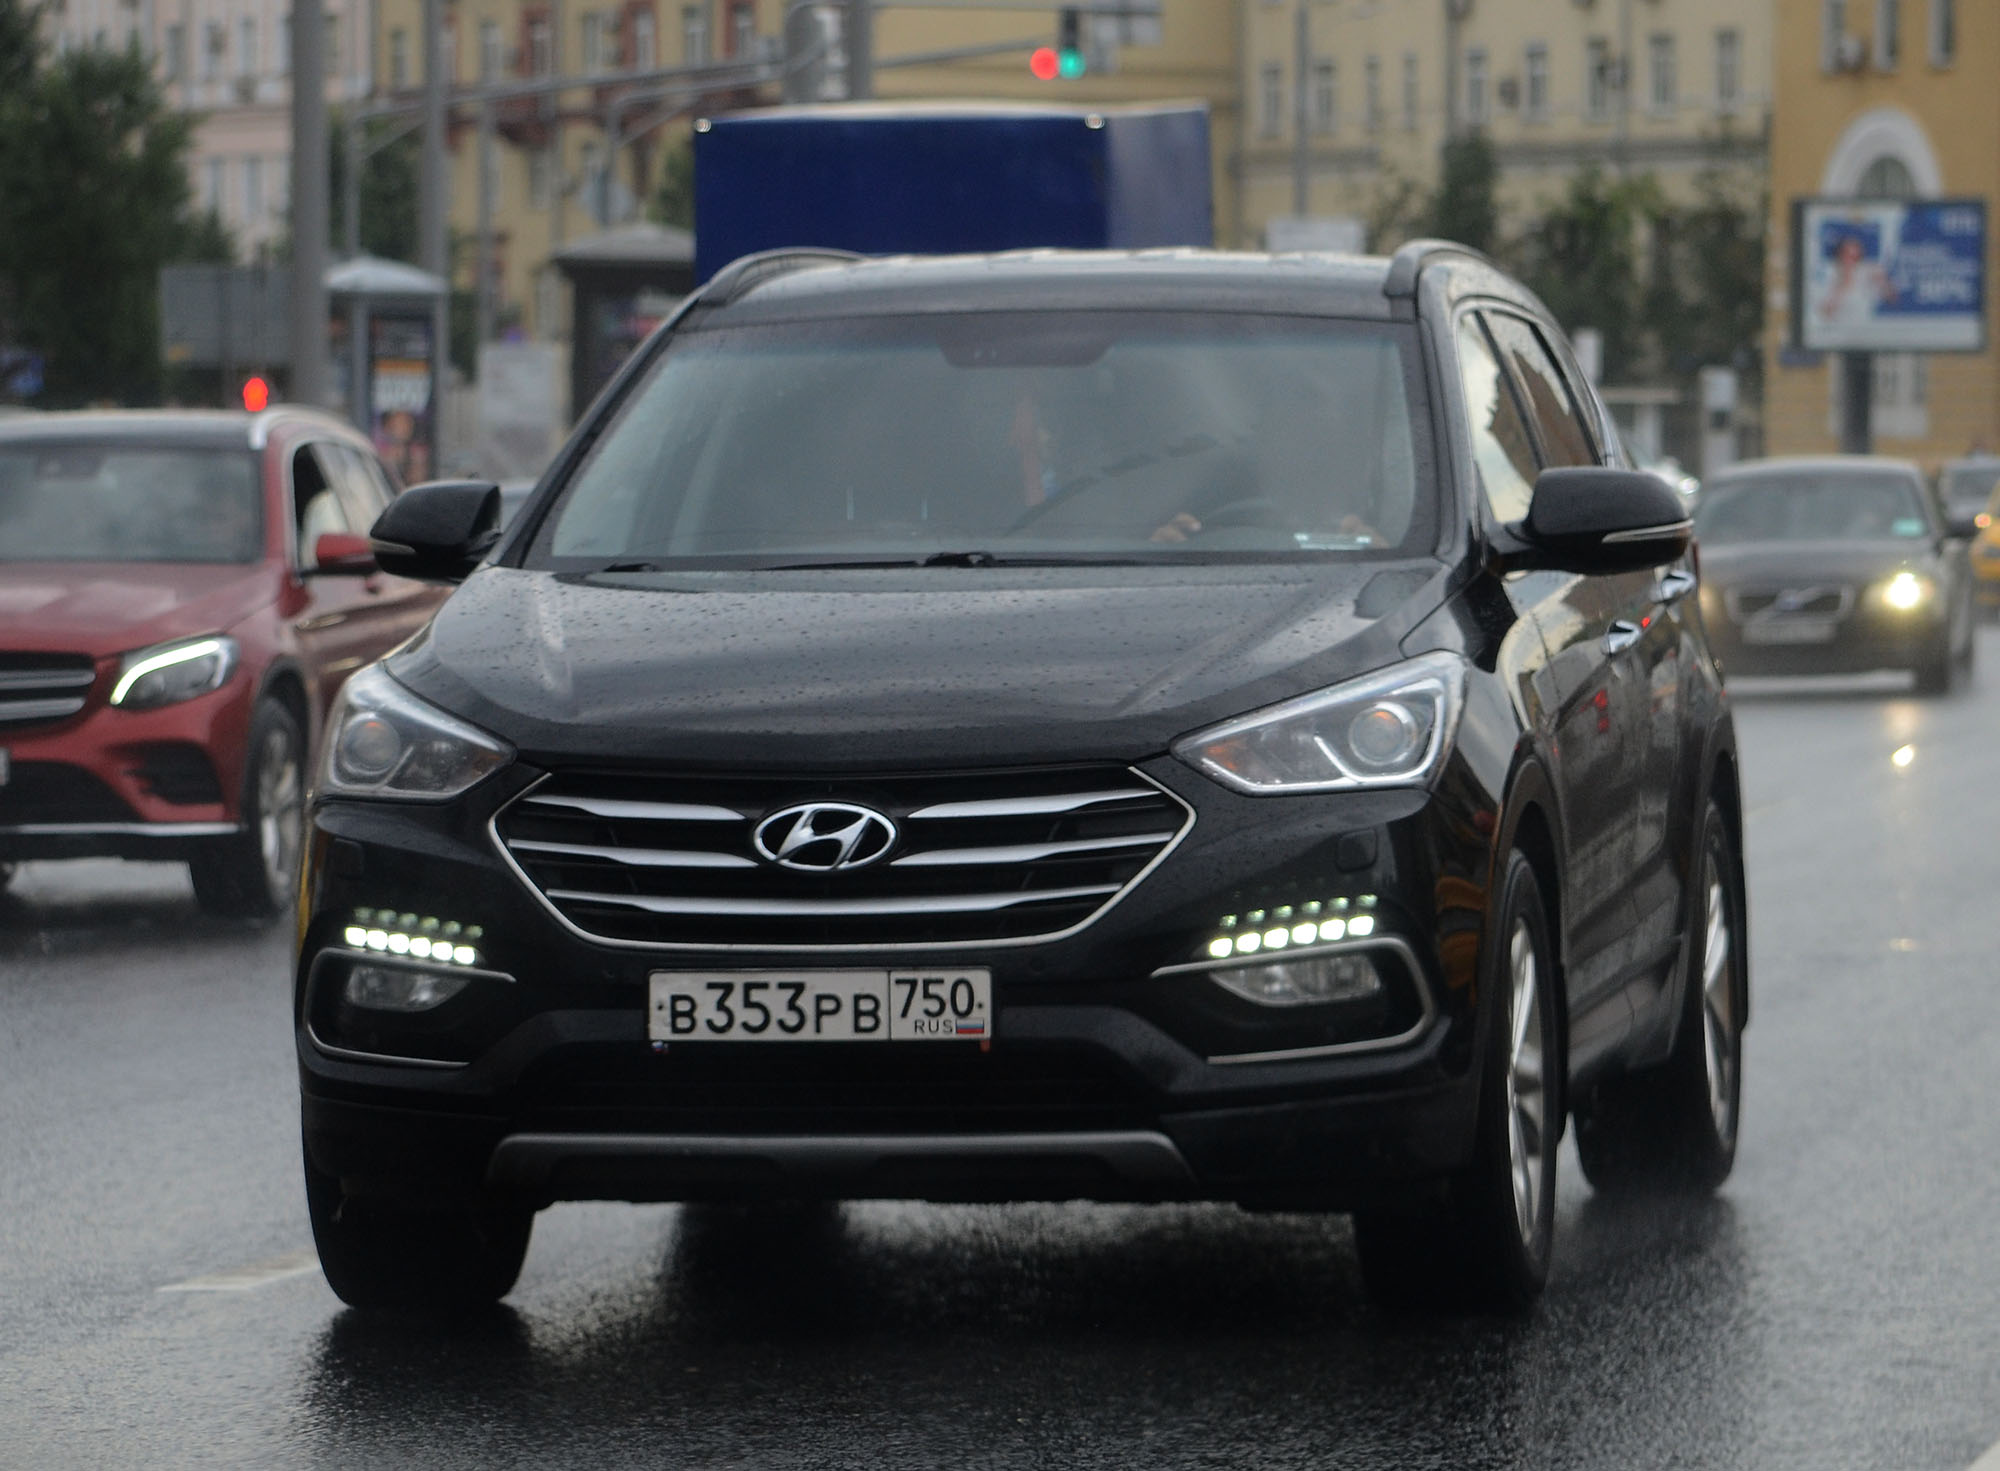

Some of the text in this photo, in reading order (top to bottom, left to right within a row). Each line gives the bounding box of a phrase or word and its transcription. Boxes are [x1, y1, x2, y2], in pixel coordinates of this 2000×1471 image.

[670, 978, 975, 1034] В353РВ 750
[914, 1019, 953, 1034] RUS
